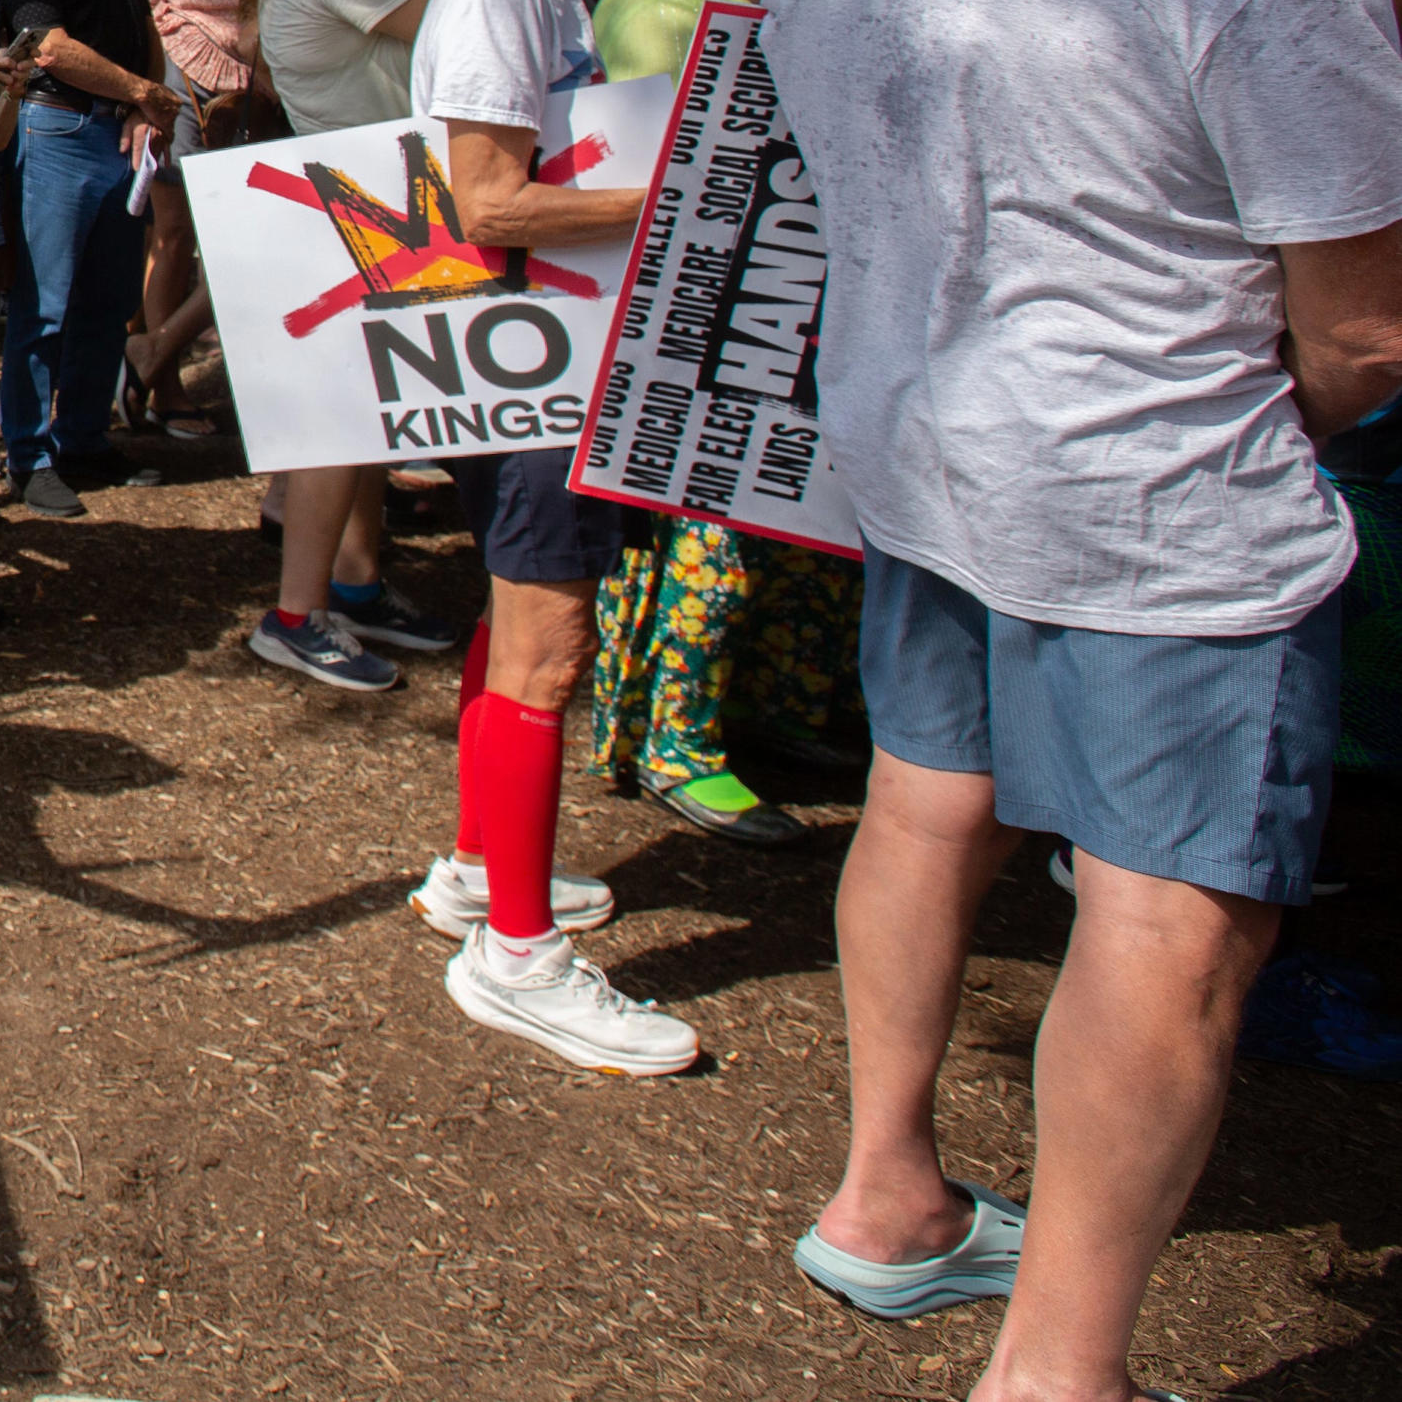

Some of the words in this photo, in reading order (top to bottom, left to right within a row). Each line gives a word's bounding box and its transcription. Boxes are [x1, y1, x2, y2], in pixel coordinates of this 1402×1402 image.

[698, 140, 762, 226] SOCIAL
[657, 241, 734, 366] MEDICARE
[361, 302, 572, 403] NO
[380, 394, 586, 450] KINGS
[622, 379, 696, 495] MEDICAID
[756, 421, 820, 502] LANDS
[682, 460, 739, 518] FAIR
